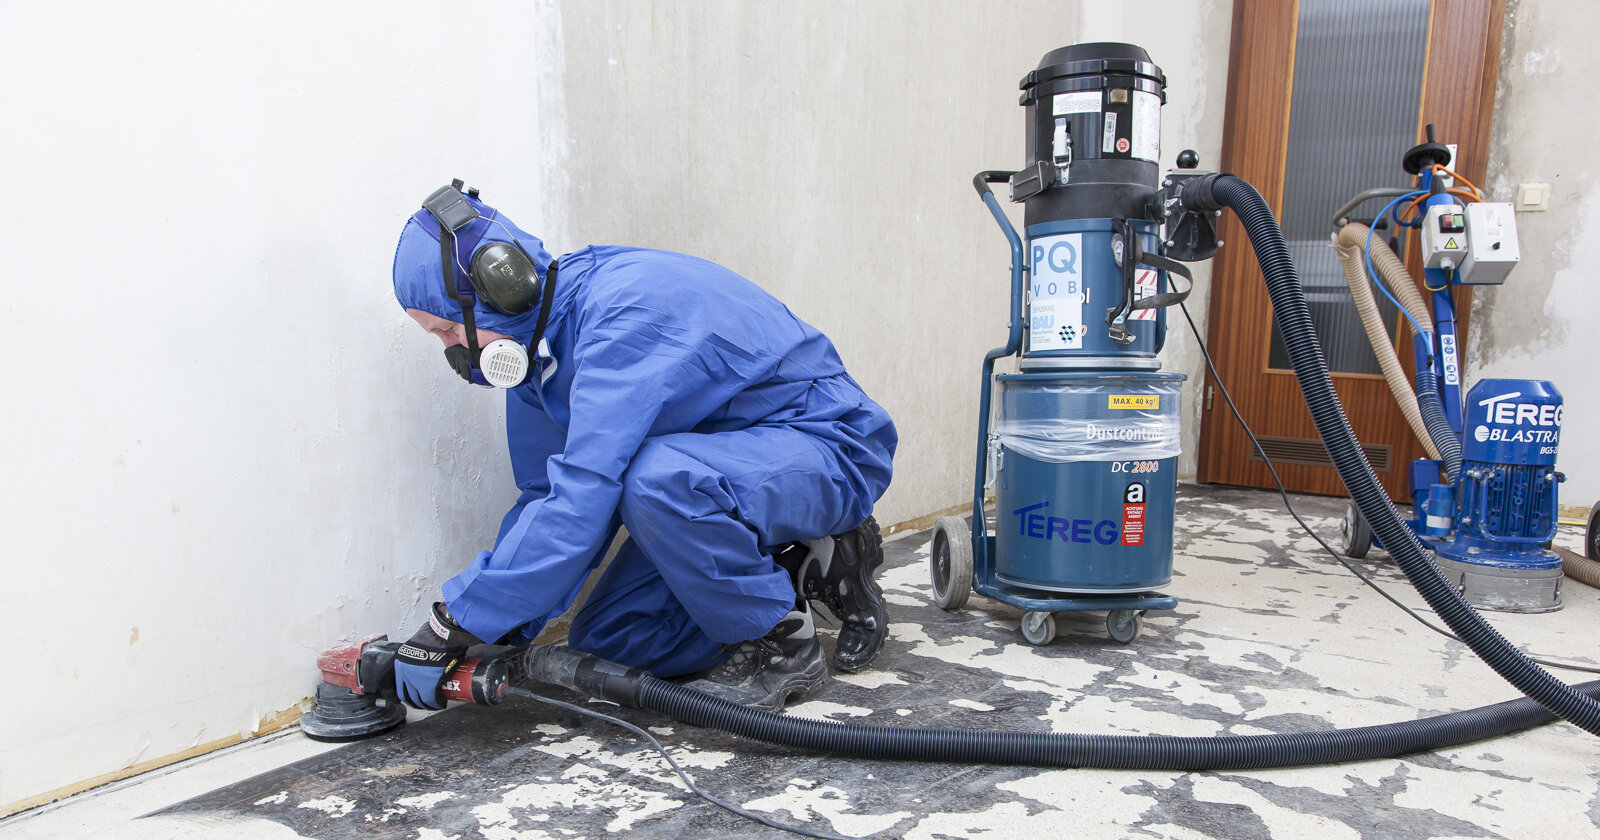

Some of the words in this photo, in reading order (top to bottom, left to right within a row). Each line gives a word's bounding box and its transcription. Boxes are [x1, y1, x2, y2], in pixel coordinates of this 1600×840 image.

[1056, 95, 1100, 112] TEREG
[1113, 397, 1133, 405] MAX.
[1135, 397, 1144, 405] 40
[1145, 397, 1156, 406] kg!
[1086, 424, 1161, 441] Dustcontrol
[1489, 429, 1559, 443] BLASTRA
[1111, 461, 1129, 473] DC
[1131, 461, 1159, 473] 2800
[1127, 483, 1143, 503] a
[1013, 501, 1118, 546] TEREG
[399, 646, 425, 658] GEDORE
